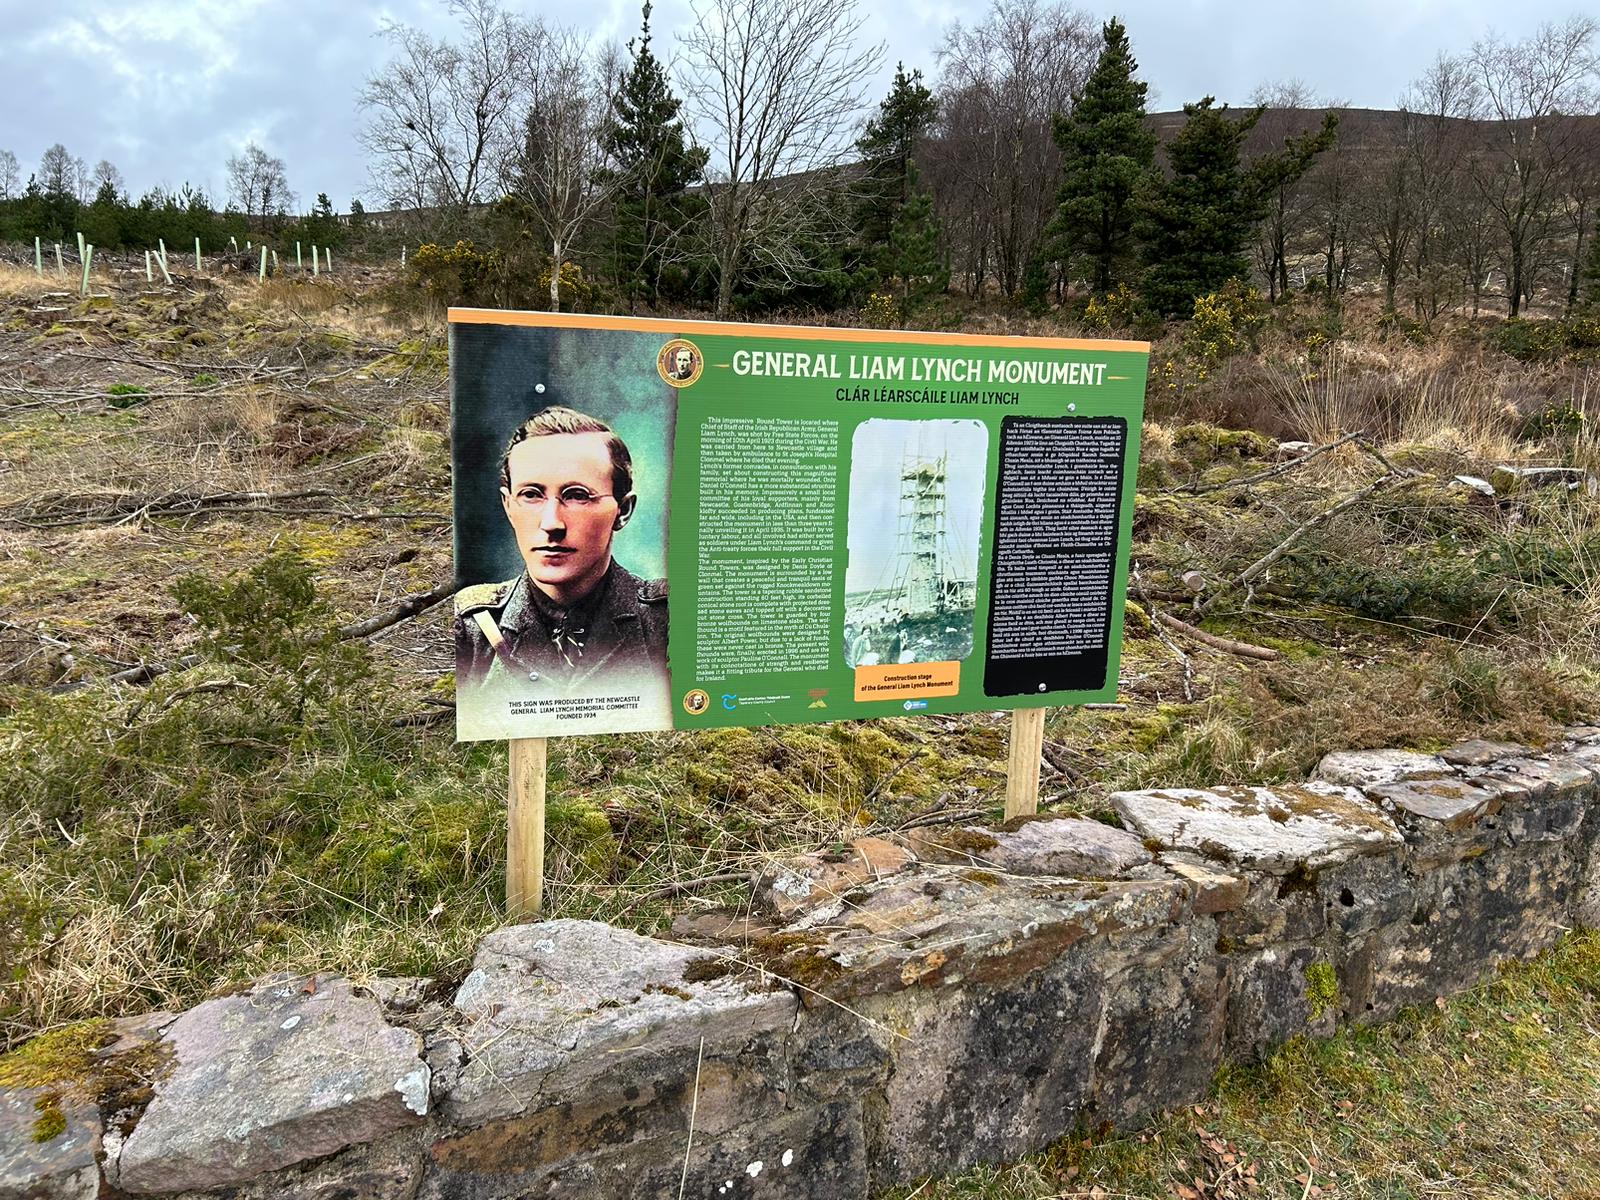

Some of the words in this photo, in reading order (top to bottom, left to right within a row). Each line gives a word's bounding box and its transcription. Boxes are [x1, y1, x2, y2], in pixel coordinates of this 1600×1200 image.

[732, 350, 842, 379] GENERAL
[849, 355, 905, 381] LIAM
[911, 357, 983, 383] LYNCH
[987, 360, 1107, 386] MONUMENT
[836, 385, 870, 402] CLÁR
[874, 386, 947, 404] LÉARSCÁILE
[950, 391, 979, 404] LIAM
[982, 392, 1019, 405] LYNCH
[877, 683, 897, 691] General
[897, 682, 910, 690] Liam
[911, 682, 926, 690] Lynch
[926, 680, 953, 688] Monument
